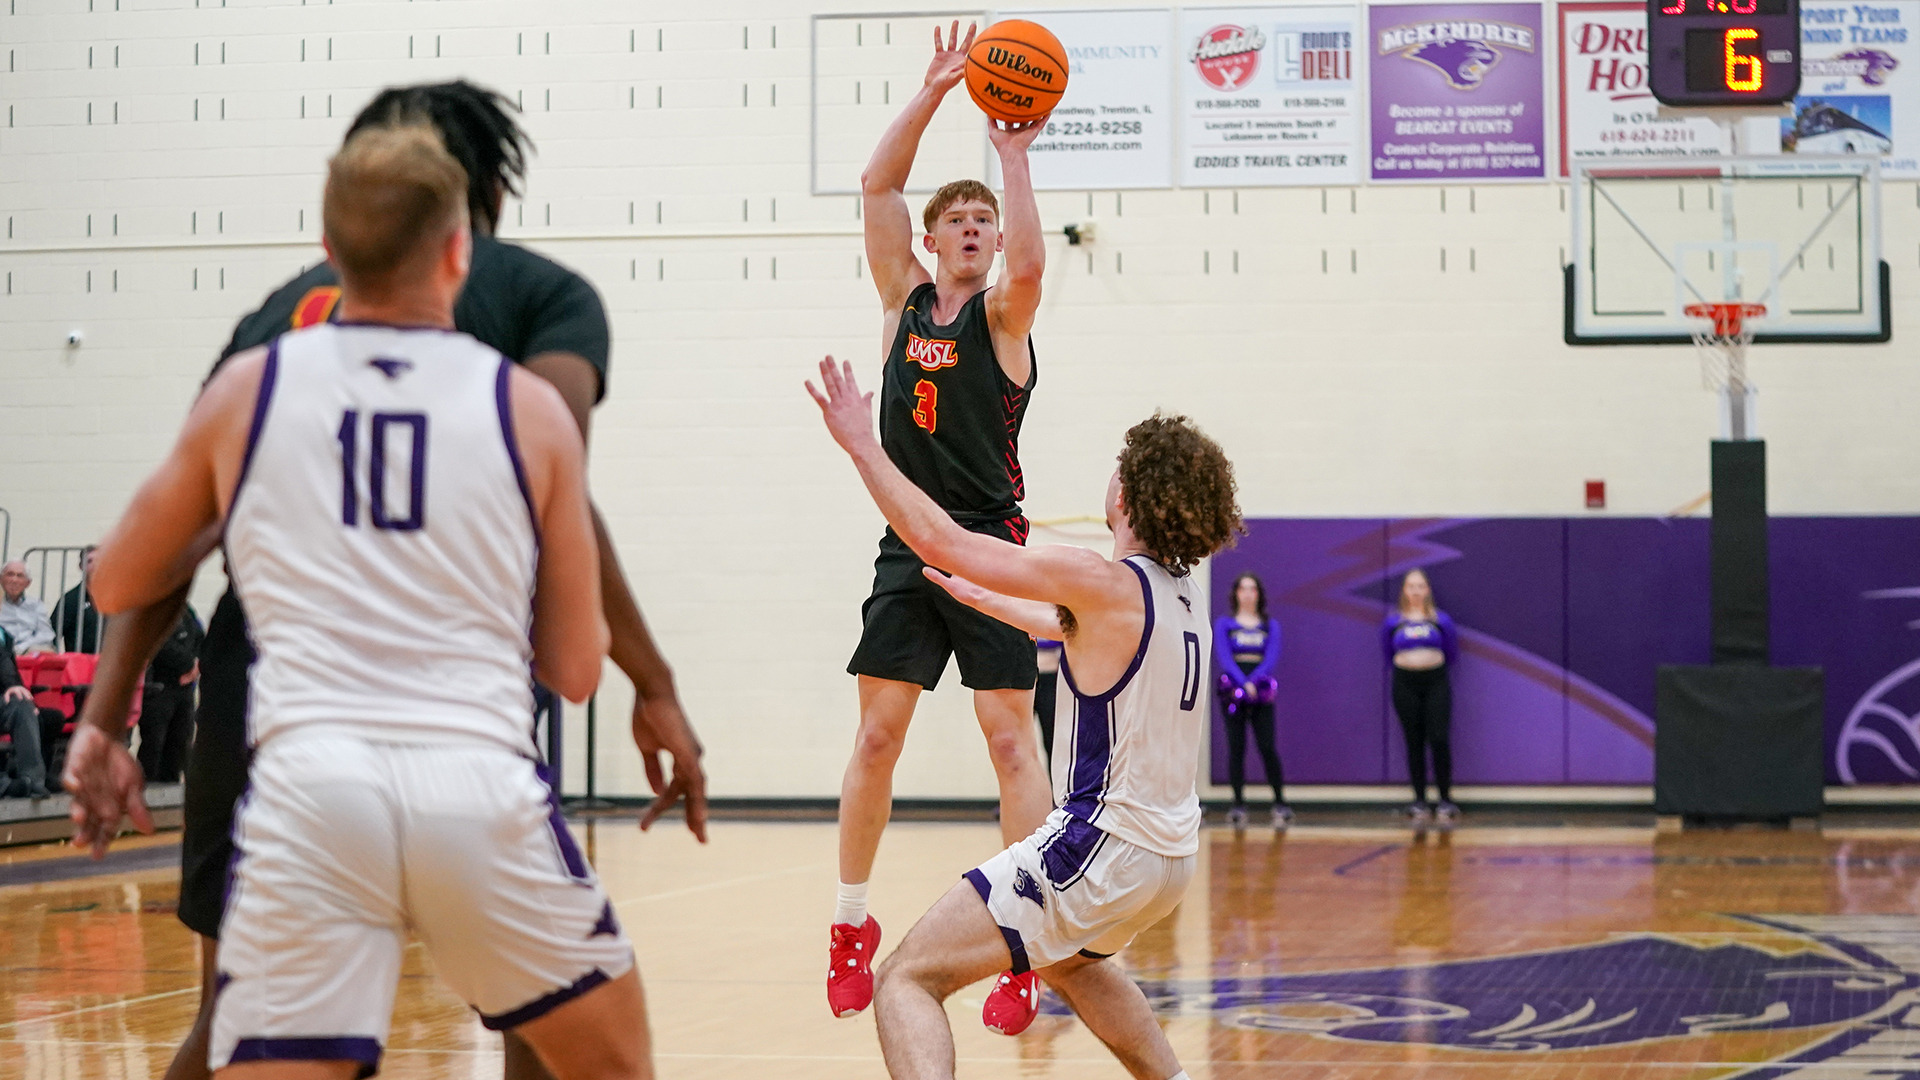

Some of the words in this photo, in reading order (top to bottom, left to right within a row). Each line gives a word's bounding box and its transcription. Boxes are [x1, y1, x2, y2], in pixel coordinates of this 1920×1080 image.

[1189, 25, 1267, 63] Huddle
[1724, 28, 1762, 91] 6
[987, 46, 1053, 84] Wilson
[984, 81, 1035, 109] NCAA
[1389, 103, 1442, 118] Become
[1444, 106, 1454, 117] a
[1456, 105, 1507, 119] sponsor
[1509, 102, 1524, 117] of
[1395, 119, 1457, 135] BEARCAT
[1459, 119, 1513, 134] EVENTS
[1194, 155, 1240, 169] EDDIES
[1244, 155, 1291, 168] TRAVEL
[1296, 153, 1348, 167] CENTER
[1374, 157, 1397, 170] Call
[1398, 159, 1412, 170] us
[1413, 157, 1444, 172] today
[1447, 158, 1458, 169] at
[1383, 143, 1427, 155] Contact
[1428, 142, 1482, 157] Corporate
[1484, 141, 1535, 154] Relations
[907, 335, 957, 370] UMSL
[913, 378, 938, 434] 3
[337, 409, 428, 529] 10
[1180, 631, 1201, 711] 0
